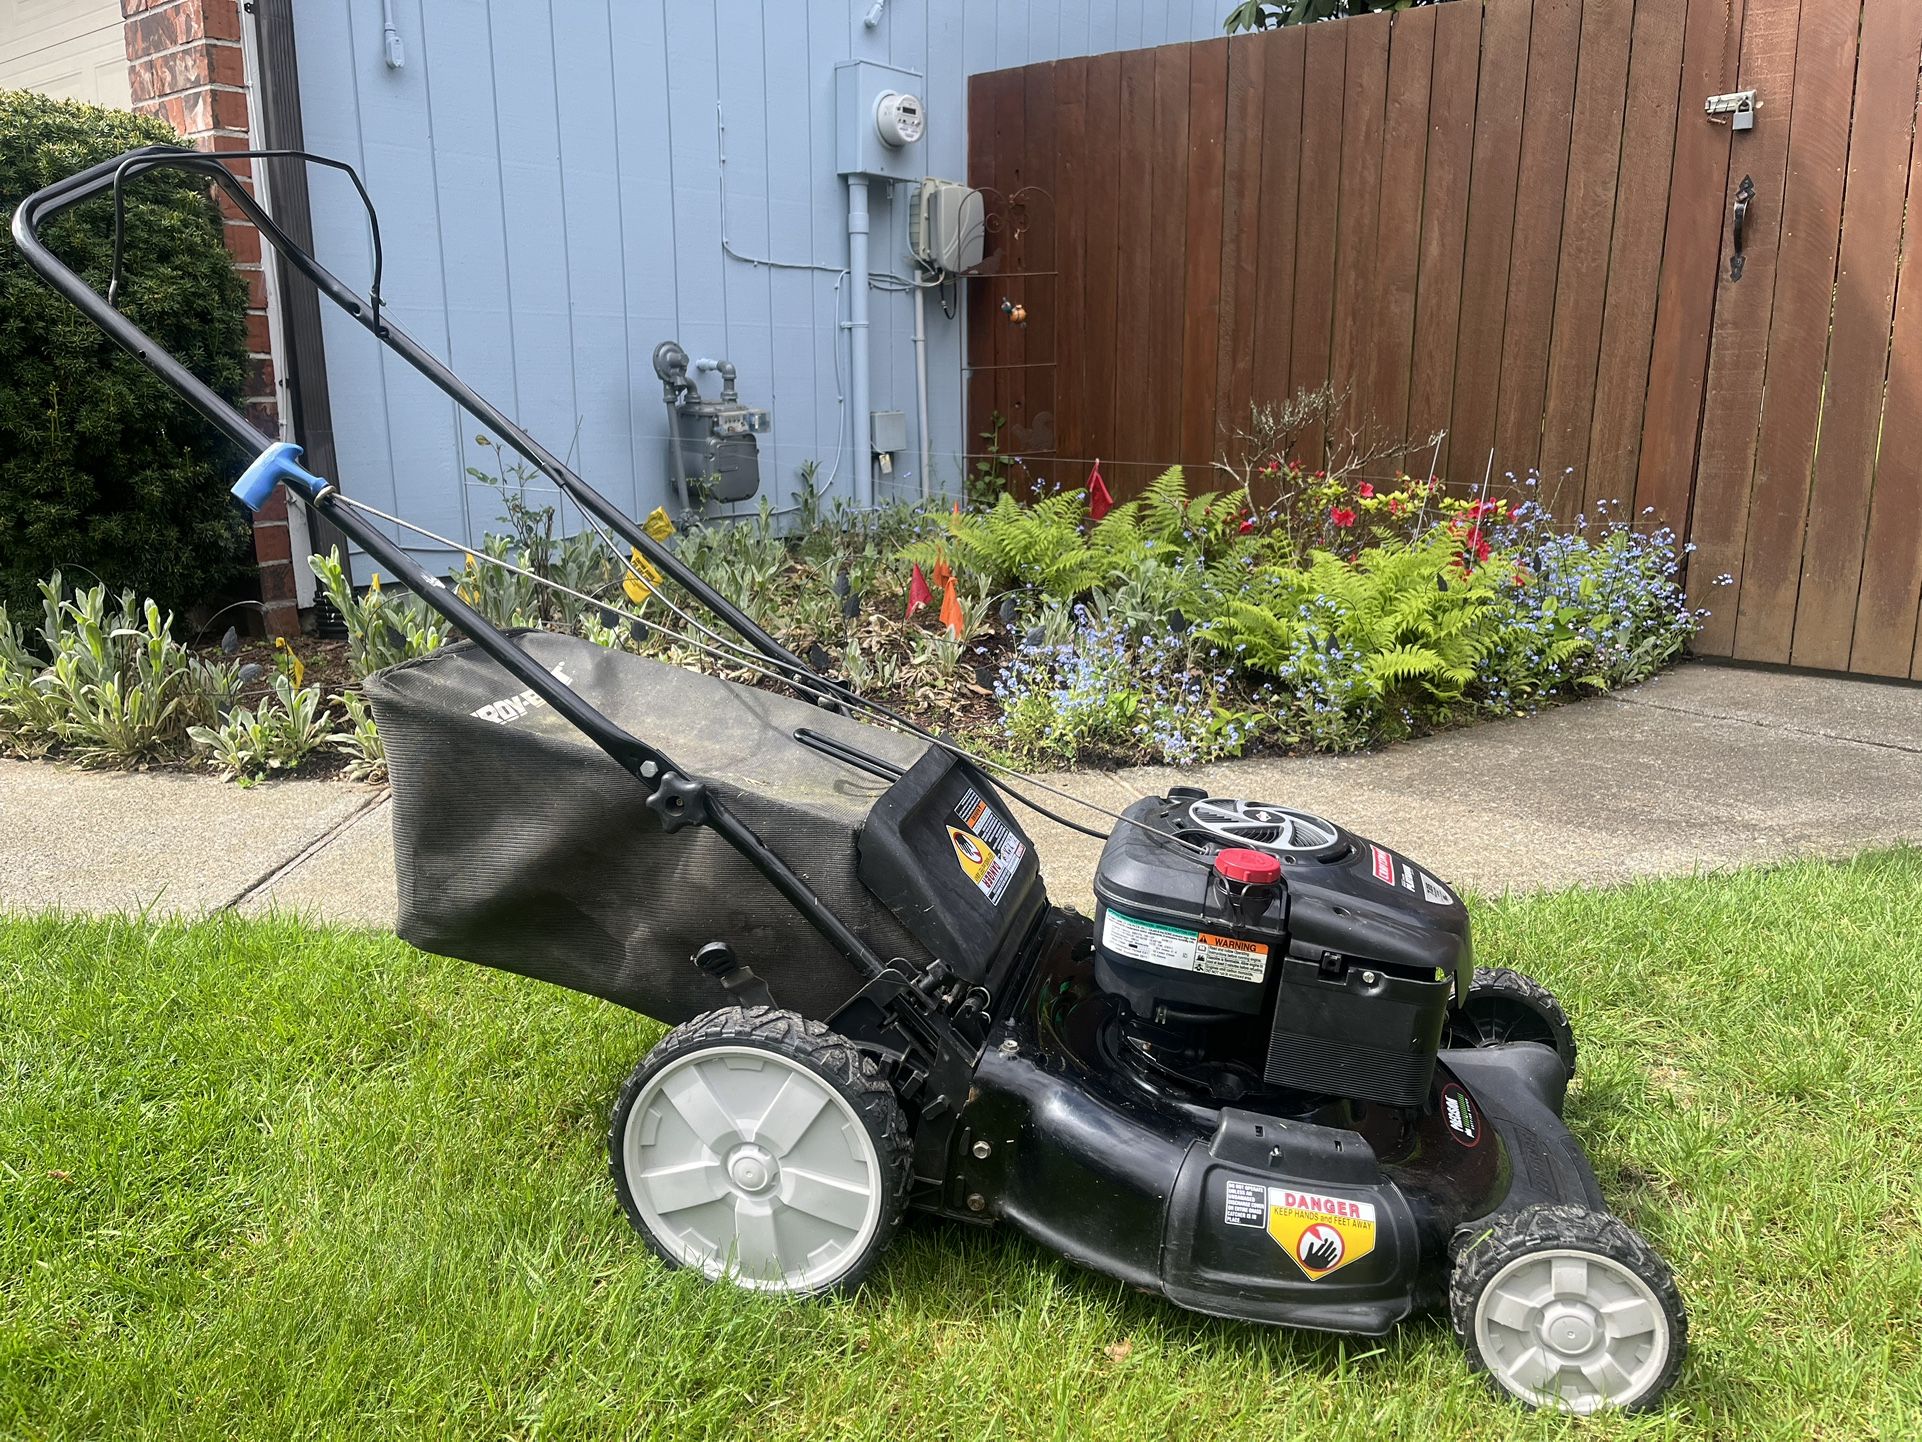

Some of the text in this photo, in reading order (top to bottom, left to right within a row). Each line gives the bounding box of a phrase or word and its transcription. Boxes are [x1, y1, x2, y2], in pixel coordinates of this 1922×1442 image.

[1214, 937, 1257, 953] WARNING
[1284, 1192, 1361, 1219] DANGER
[1274, 1207, 1372, 1230] KEEP HANDS and FEET AWAY
